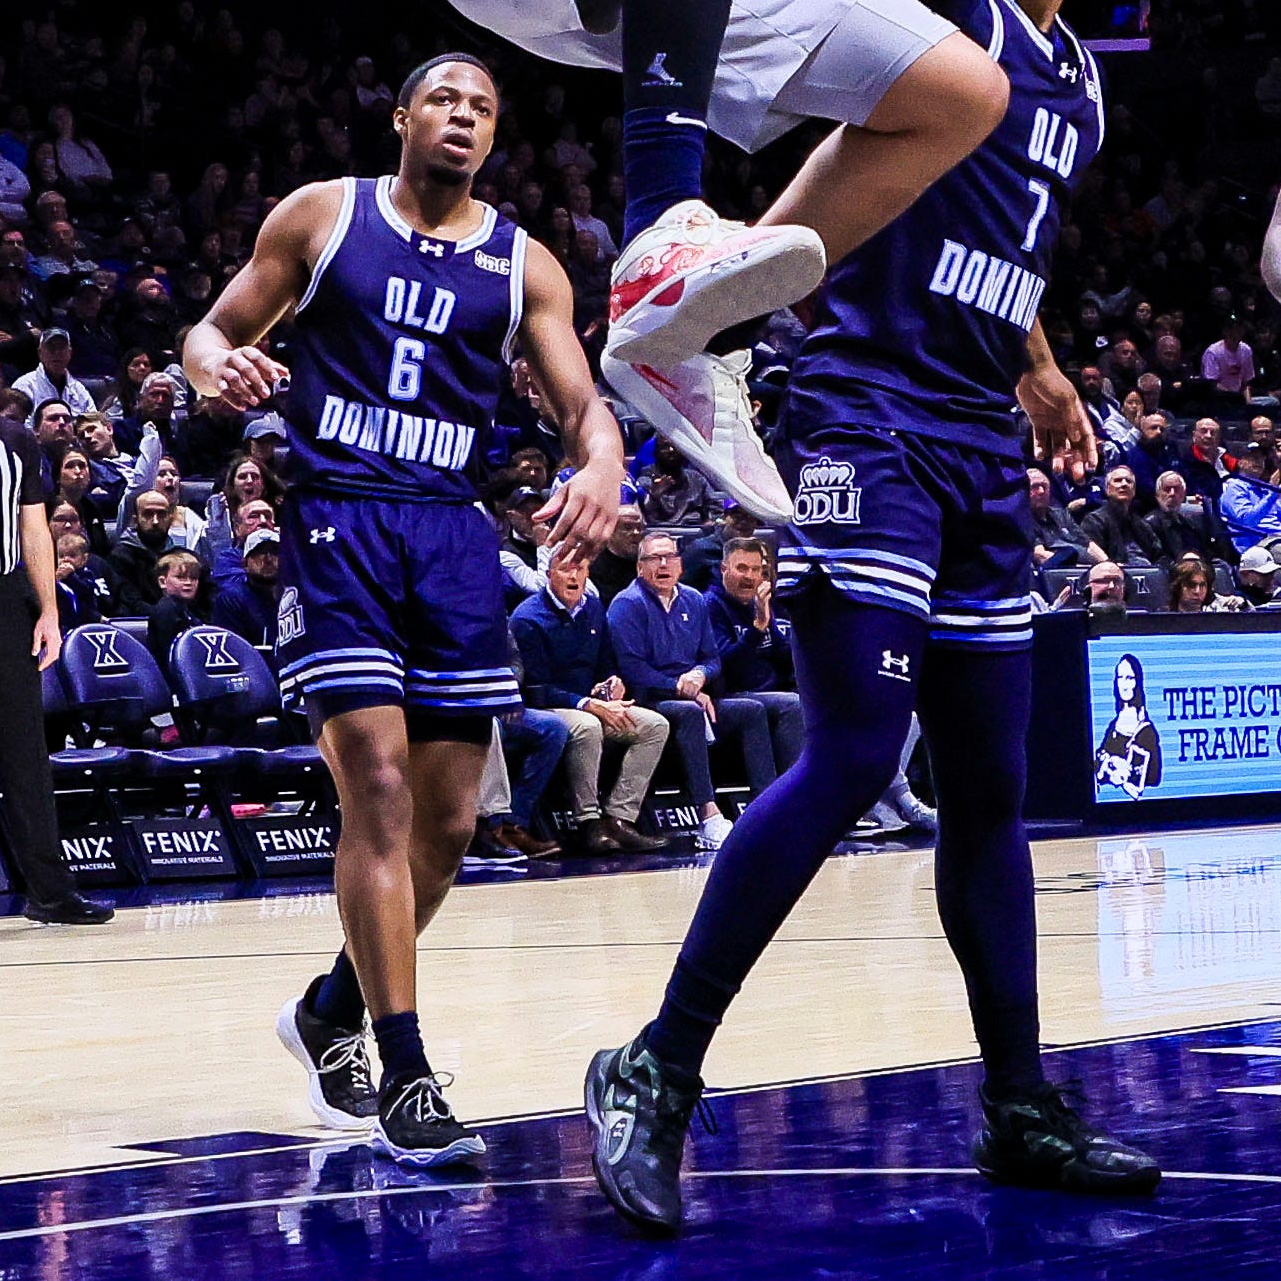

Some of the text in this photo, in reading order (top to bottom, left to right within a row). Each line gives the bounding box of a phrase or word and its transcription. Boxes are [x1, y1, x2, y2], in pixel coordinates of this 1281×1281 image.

[1029, 107, 1078, 180] OLD
[1020, 180, 1051, 252] 7
[384, 276, 457, 335] OLD
[387, 336, 426, 402] 6
[317, 395, 476, 470] DOMINION
[792, 488, 861, 525] ODU
[1163, 685, 1217, 721] THE
[1177, 725, 1270, 762] FRAME
[61, 835, 110, 862] NIX
[142, 830, 218, 855] FENIX
[255, 826, 329, 852] FENIX
